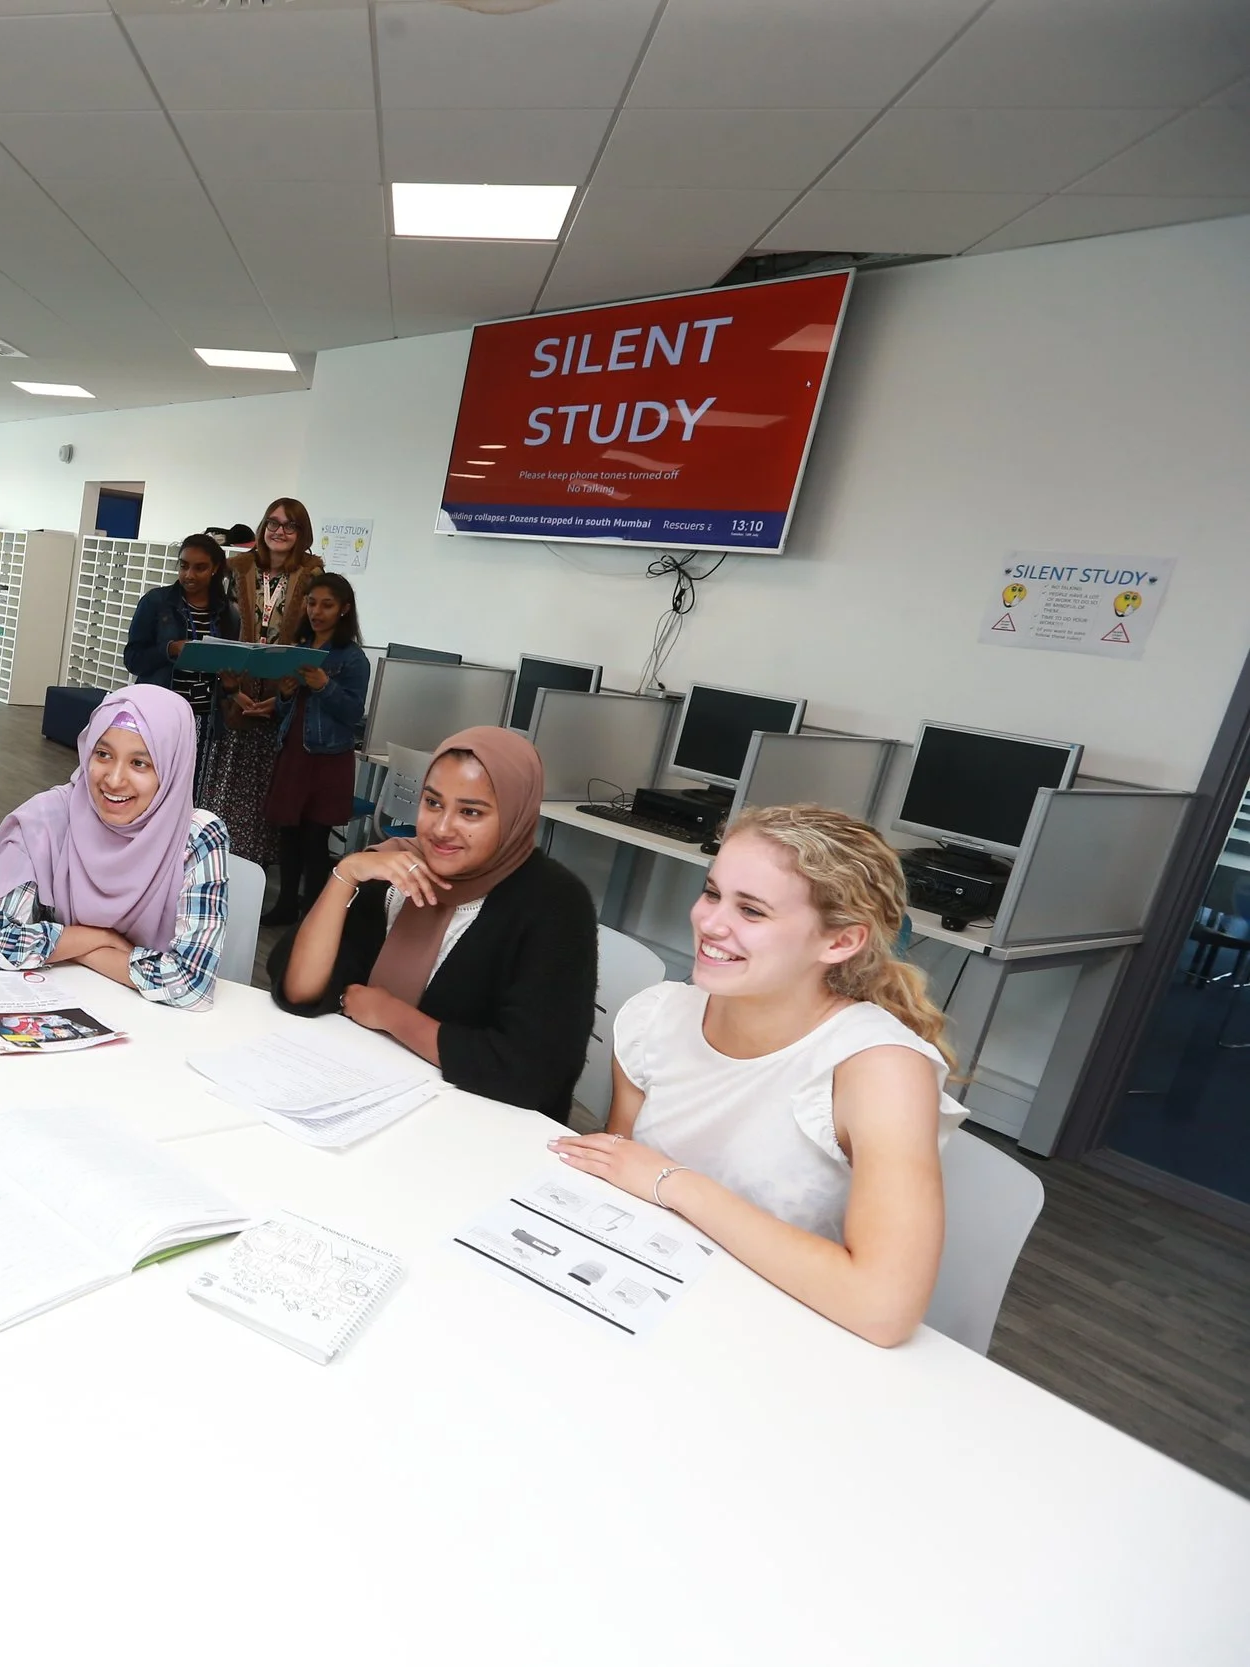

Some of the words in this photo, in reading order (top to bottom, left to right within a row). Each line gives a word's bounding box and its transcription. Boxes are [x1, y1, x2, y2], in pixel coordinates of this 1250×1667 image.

[529, 316, 733, 378] SILENT
[524, 397, 717, 446] STUDY
[519, 470, 546, 480] Please
[547, 471, 568, 483] keep
[569, 471, 598, 483] phone
[599, 471, 627, 480] tones
[628, 469, 662, 480] turned
[663, 469, 681, 480] off
[566, 483, 581, 493] No
[582, 483, 615, 495] Talking
[449, 512, 473, 522] uilding
[474, 513, 508, 523] collapse:
[509, 514, 539, 524] Dozens
[540, 515, 574, 526] trapped
[574, 516, 584, 526] in
[585, 517, 611, 527] south
[613, 518, 652, 529] Mumbai
[662, 520, 705, 531] Rescuers
[731, 519, 764, 532] 13:10
[324, 525, 344, 534] SILENT
[344, 526, 366, 535] STUDY
[1013, 564, 1078, 582] SILENT
[1079, 568, 1148, 586] STUDY
